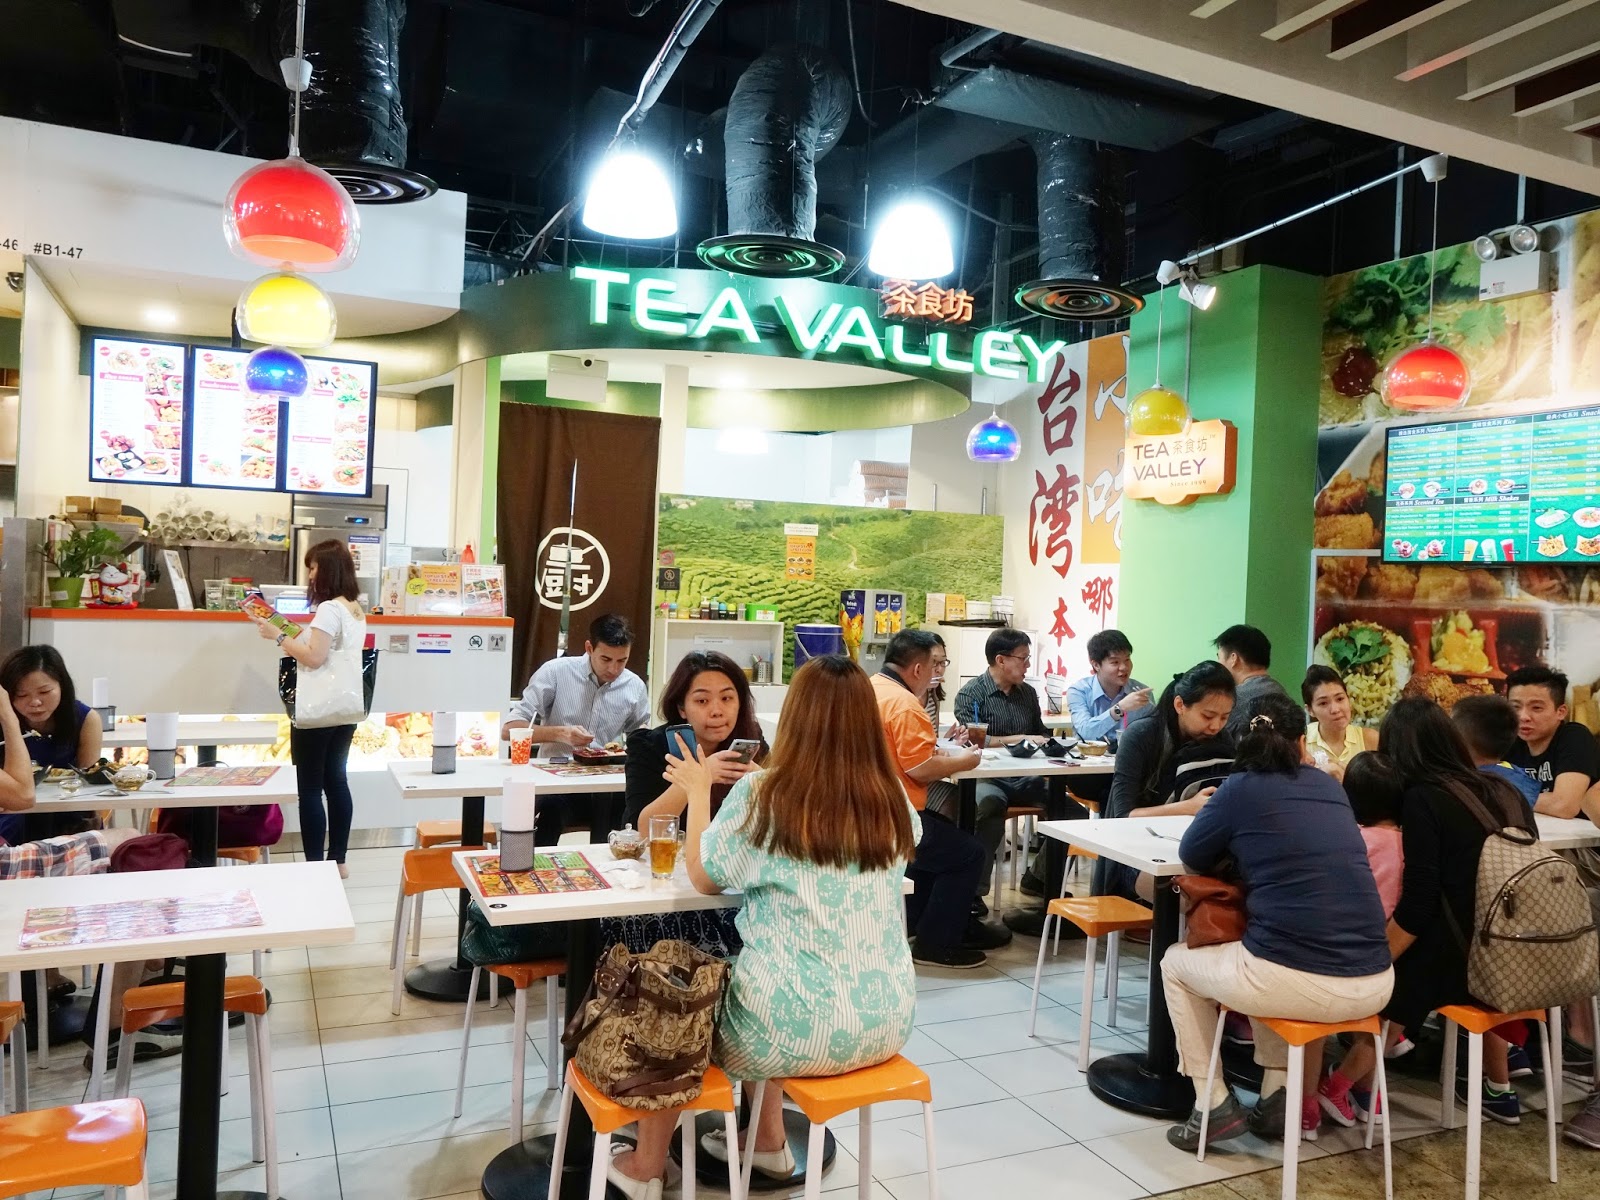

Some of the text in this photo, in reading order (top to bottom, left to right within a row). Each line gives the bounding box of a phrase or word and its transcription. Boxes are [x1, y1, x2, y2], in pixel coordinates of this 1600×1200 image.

[33, 242, 83, 259] #B1-47
[881, 279, 975, 325] 茶食坊
[570, 264, 1067, 383] TEA VALLEY
[1133, 441, 1169, 460] TEA
[1173, 436, 1208, 455] 茶食坊
[1133, 457, 1206, 481] VALLEY
